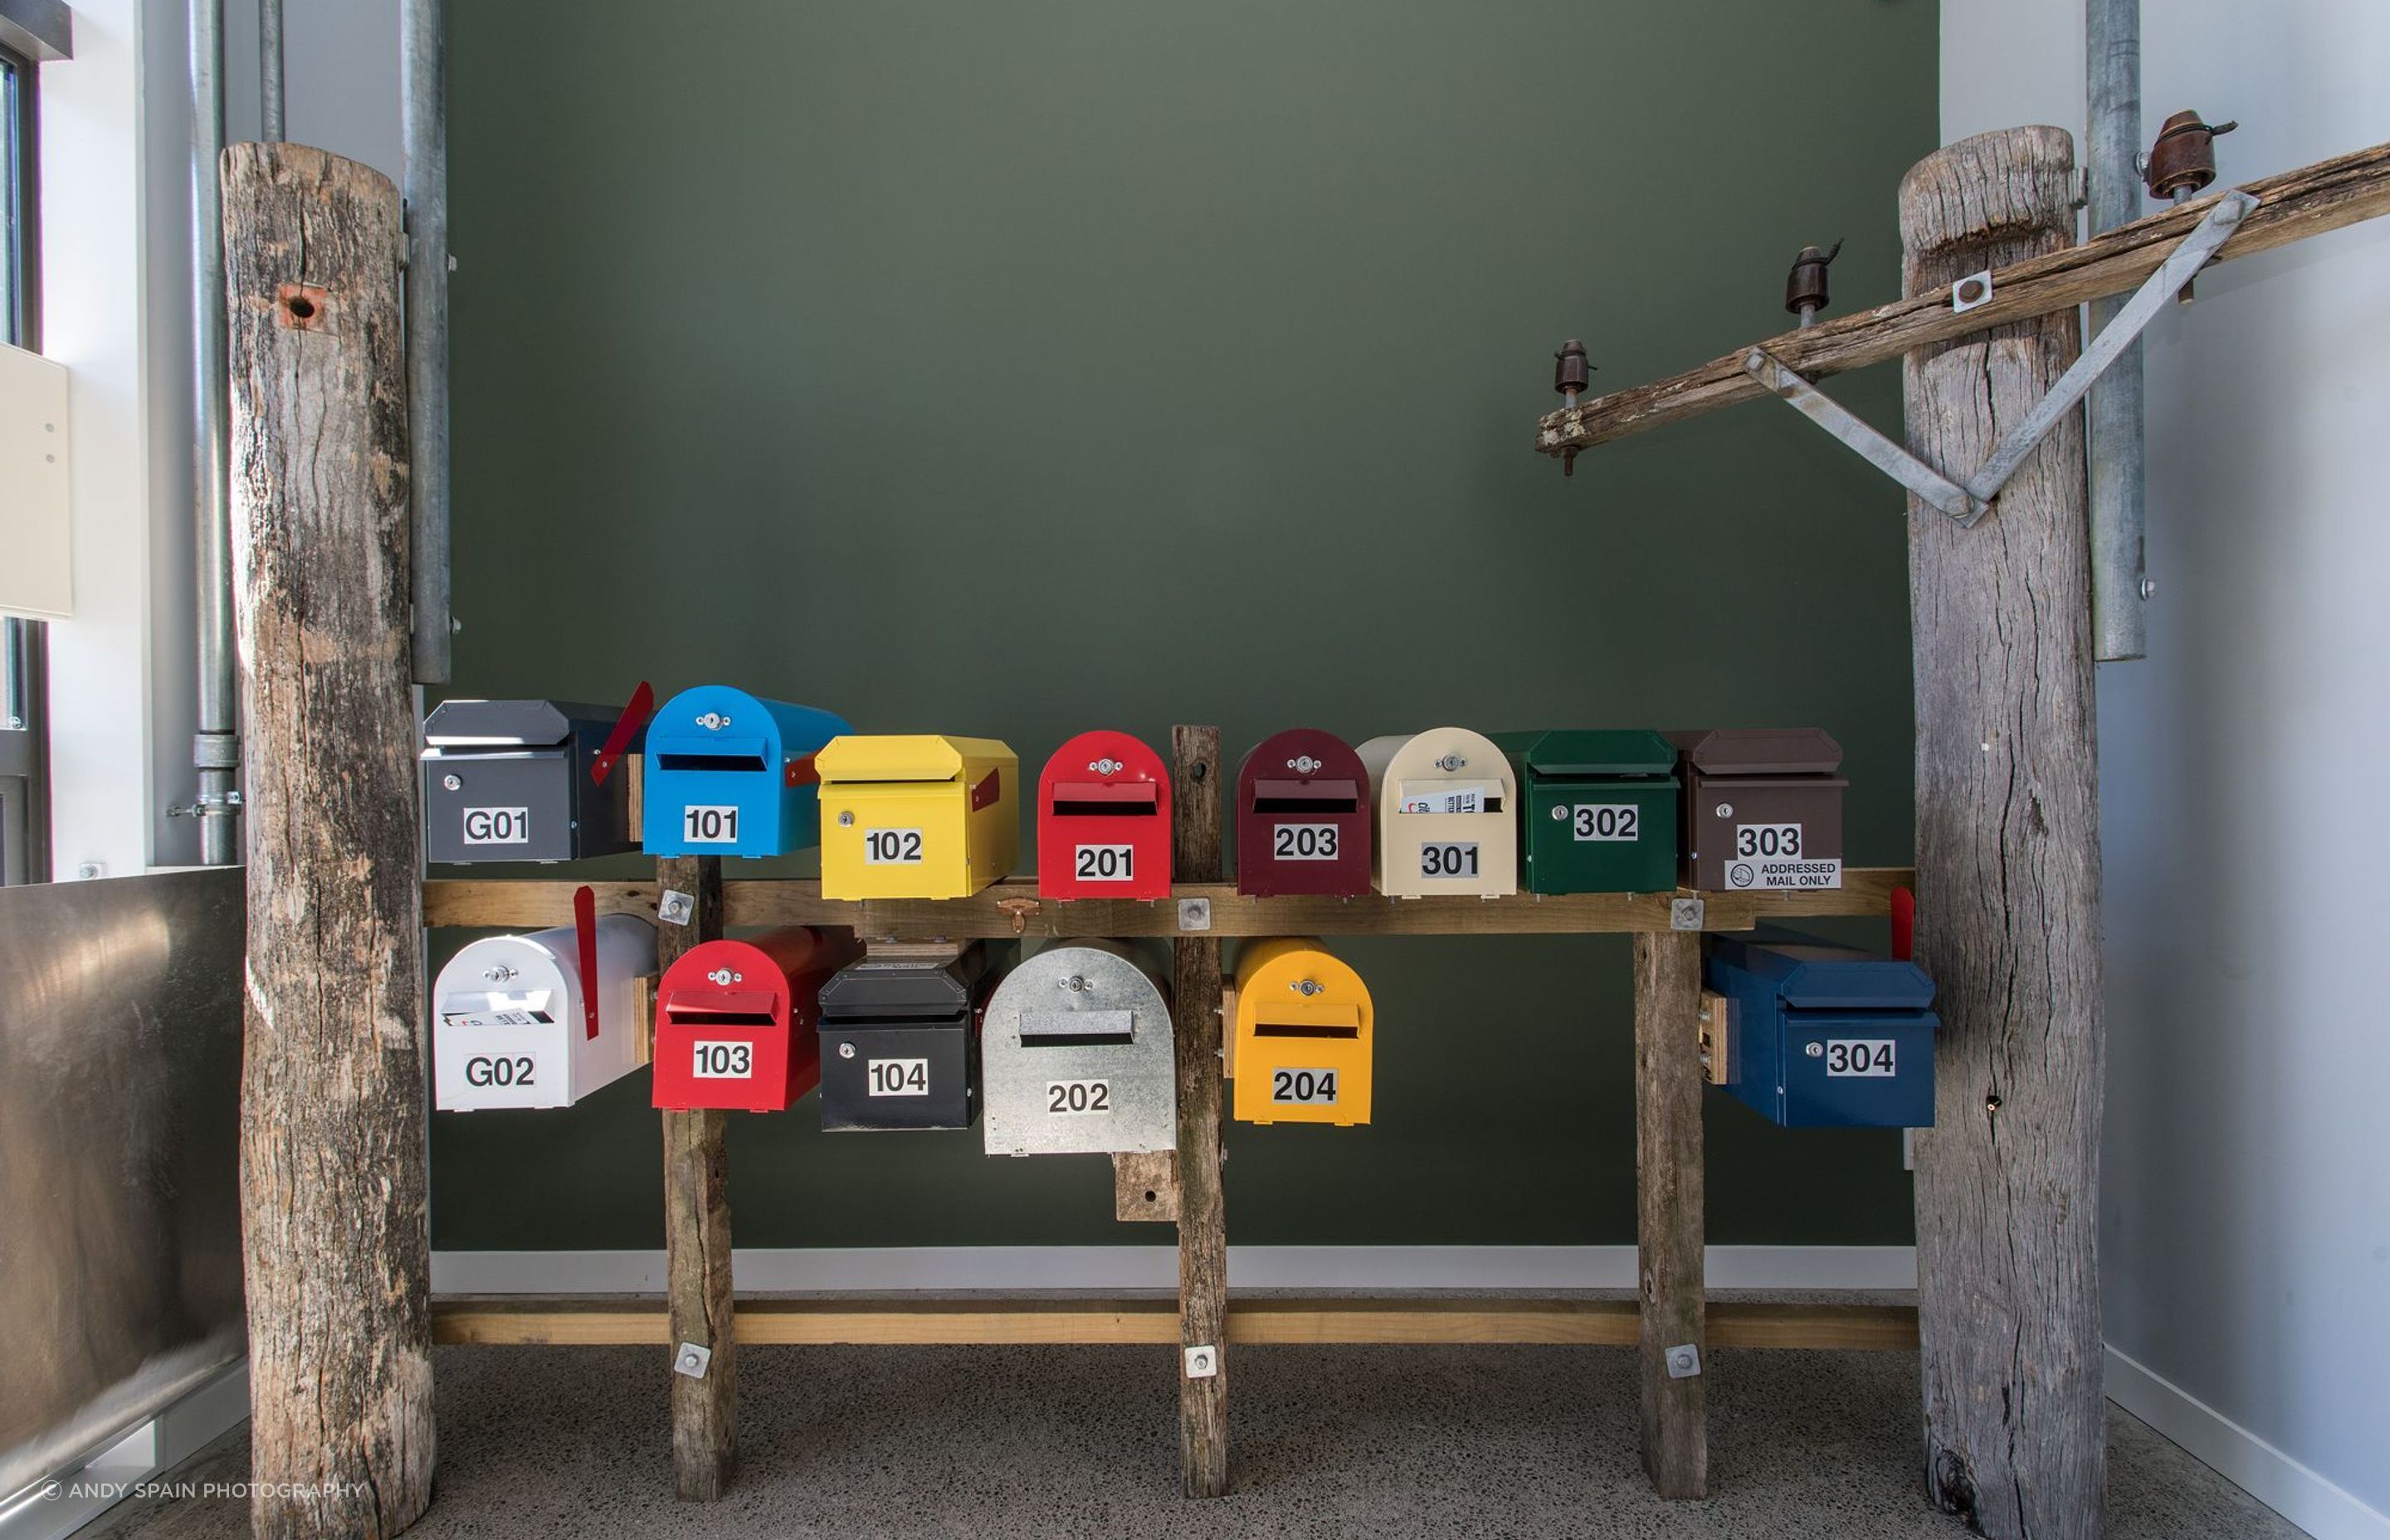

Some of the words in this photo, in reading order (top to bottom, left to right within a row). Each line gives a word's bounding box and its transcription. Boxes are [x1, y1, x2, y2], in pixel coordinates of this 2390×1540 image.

[465, 811, 527, 840] G01
[686, 810, 737, 838] 101
[1575, 809, 1636, 837] 302
[866, 832, 922, 860] 102
[1275, 828, 1338, 856] 203
[1739, 828, 1800, 856] 303
[1077, 848, 1132, 876] 201
[1422, 846, 1478, 875] 301
[1761, 863, 1836, 875] ADDRESSED
[1766, 876, 1796, 886] MAIL
[1799, 875, 1832, 885] ONLY
[466, 1057, 534, 1086] G02
[695, 1045, 750, 1074] 103
[1829, 1044, 1894, 1072] 304
[871, 1064, 927, 1092] 104
[1275, 1072, 1337, 1100] 204
[1049, 1084, 1109, 1112] 202
